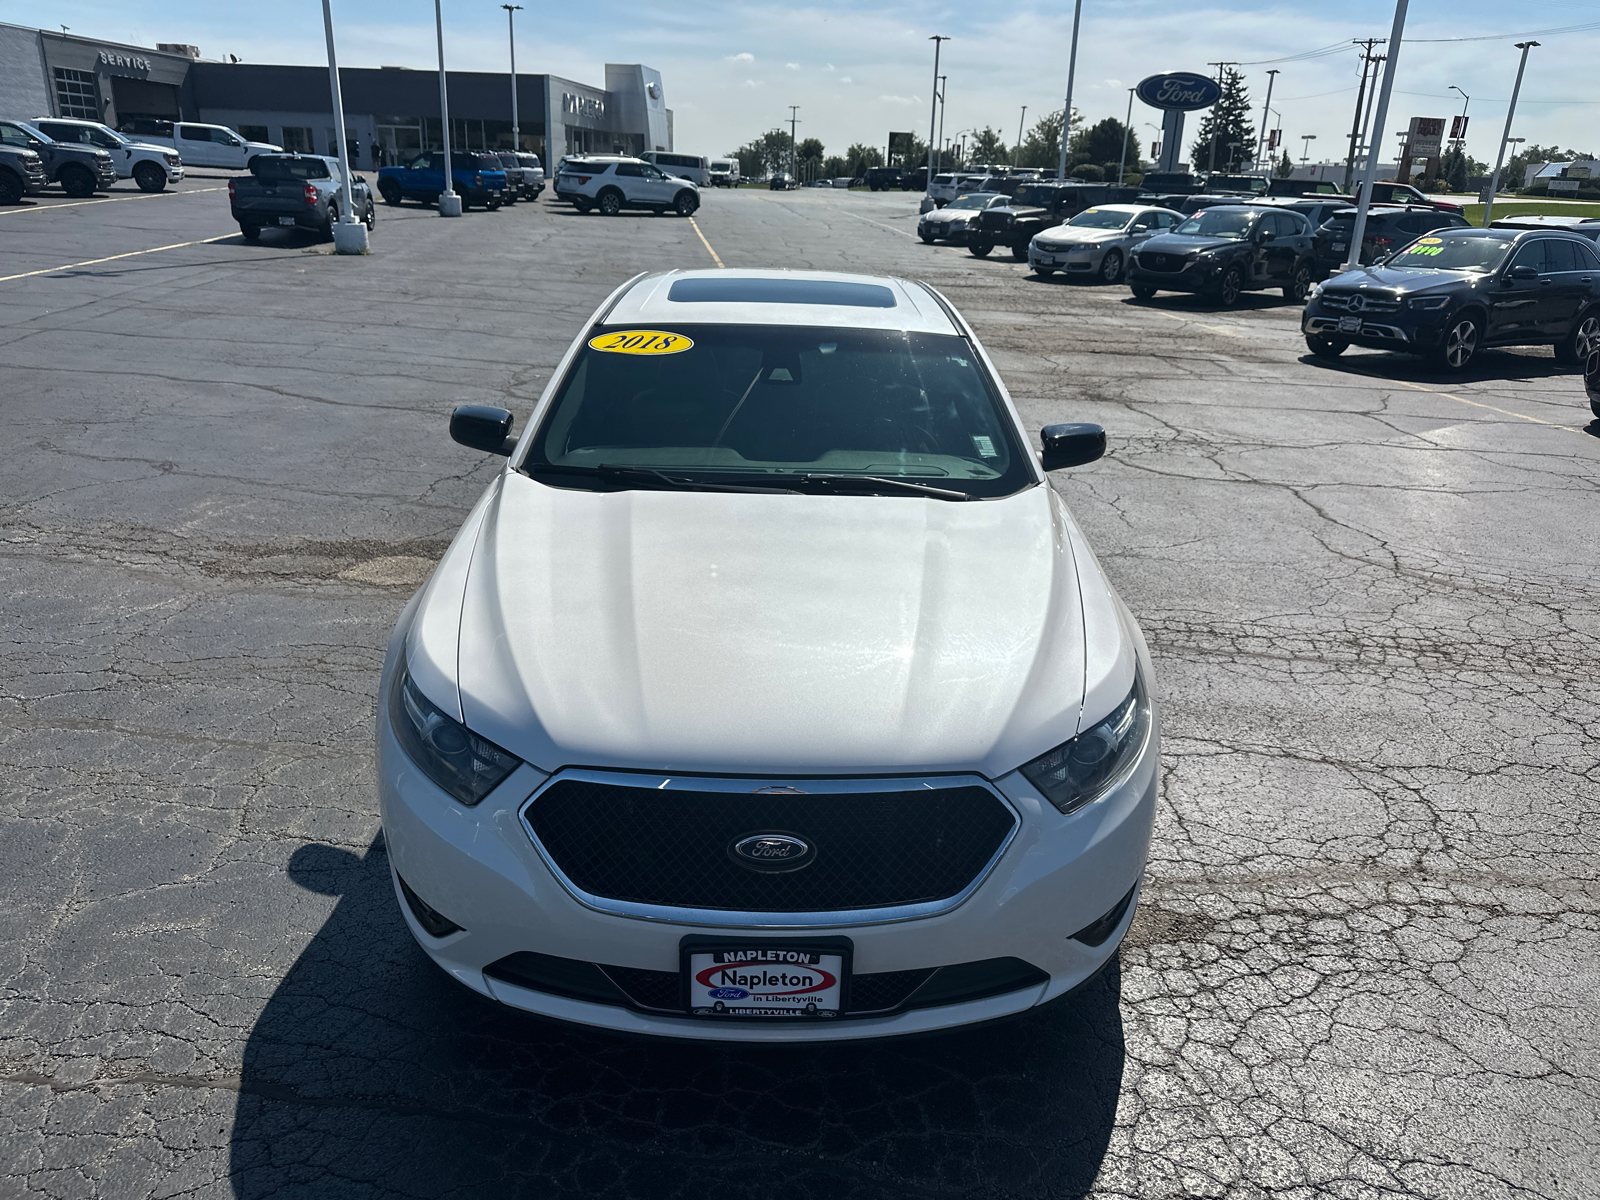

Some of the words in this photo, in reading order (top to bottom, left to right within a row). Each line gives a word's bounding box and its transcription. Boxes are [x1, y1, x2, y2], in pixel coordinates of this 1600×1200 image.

[99, 51, 151, 71] SERVICE
[1156, 79, 1206, 102] Ford
[602, 335, 678, 350] 2018
[752, 841, 791, 857] Ford
[723, 950, 810, 964] NAPLETON
[721, 970, 813, 989] Napleton
[717, 989, 741, 998] Ford
[766, 995, 824, 1004] Libertyville
[729, 1008, 802, 1016] LIBERTYVILLE
